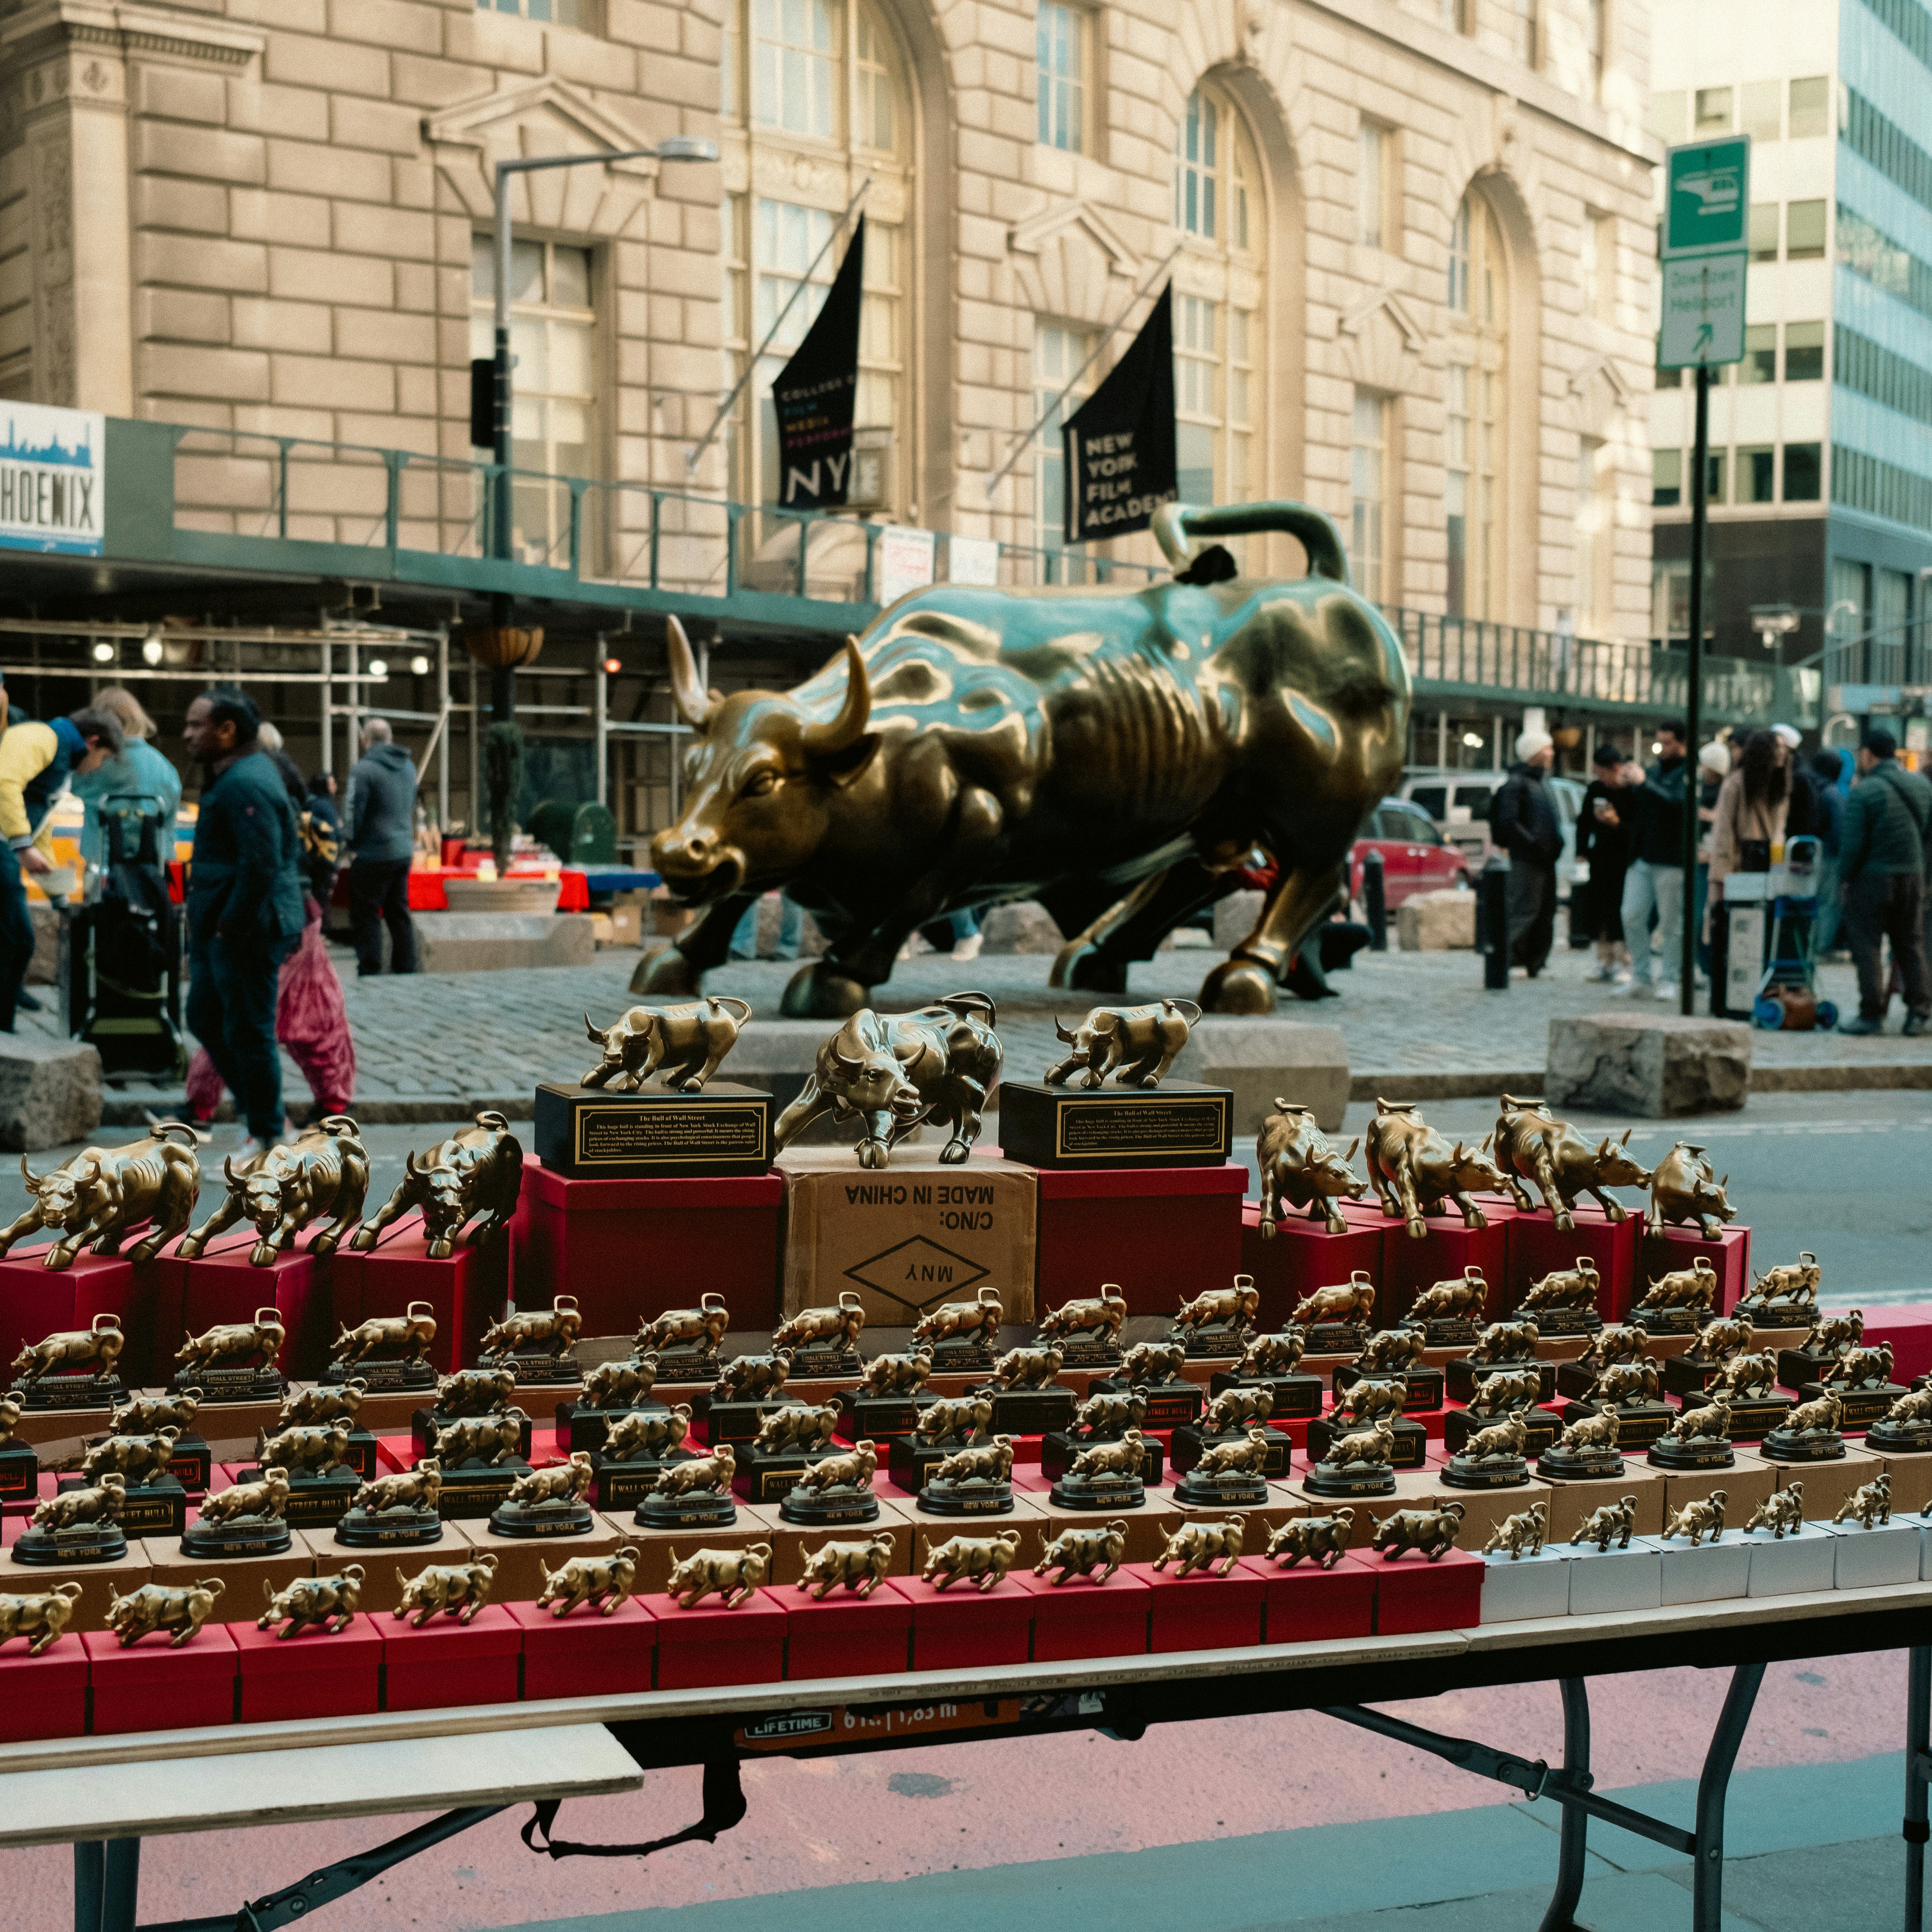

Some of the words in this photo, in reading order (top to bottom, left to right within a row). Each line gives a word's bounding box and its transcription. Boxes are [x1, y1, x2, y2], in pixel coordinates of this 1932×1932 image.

[1085, 431, 1134, 457] NEW
[1087, 452, 1138, 478] YORK
[1086, 478, 1132, 503] FILM
[845, 1185, 907, 1205] CHINA
[913, 1185, 933, 1204] IN
[937, 1185, 994, 1204] MADE
[940, 1211, 993, 1230] C/NO:
[904, 1264, 953, 1283] MNY
[174, 1467, 194, 1476] BULL
[618, 1484, 638, 1493] WALL
[289, 1501, 319, 1510] STREET
[322, 1500, 342, 1508] BULL
[444, 1495, 464, 1503] WALL
[468, 1494, 496, 1503] STREET
[145, 1509, 165, 1518] BULL
[79, 1547, 101, 1556] YORK
[754, 1717, 822, 1735] LIFETIME
